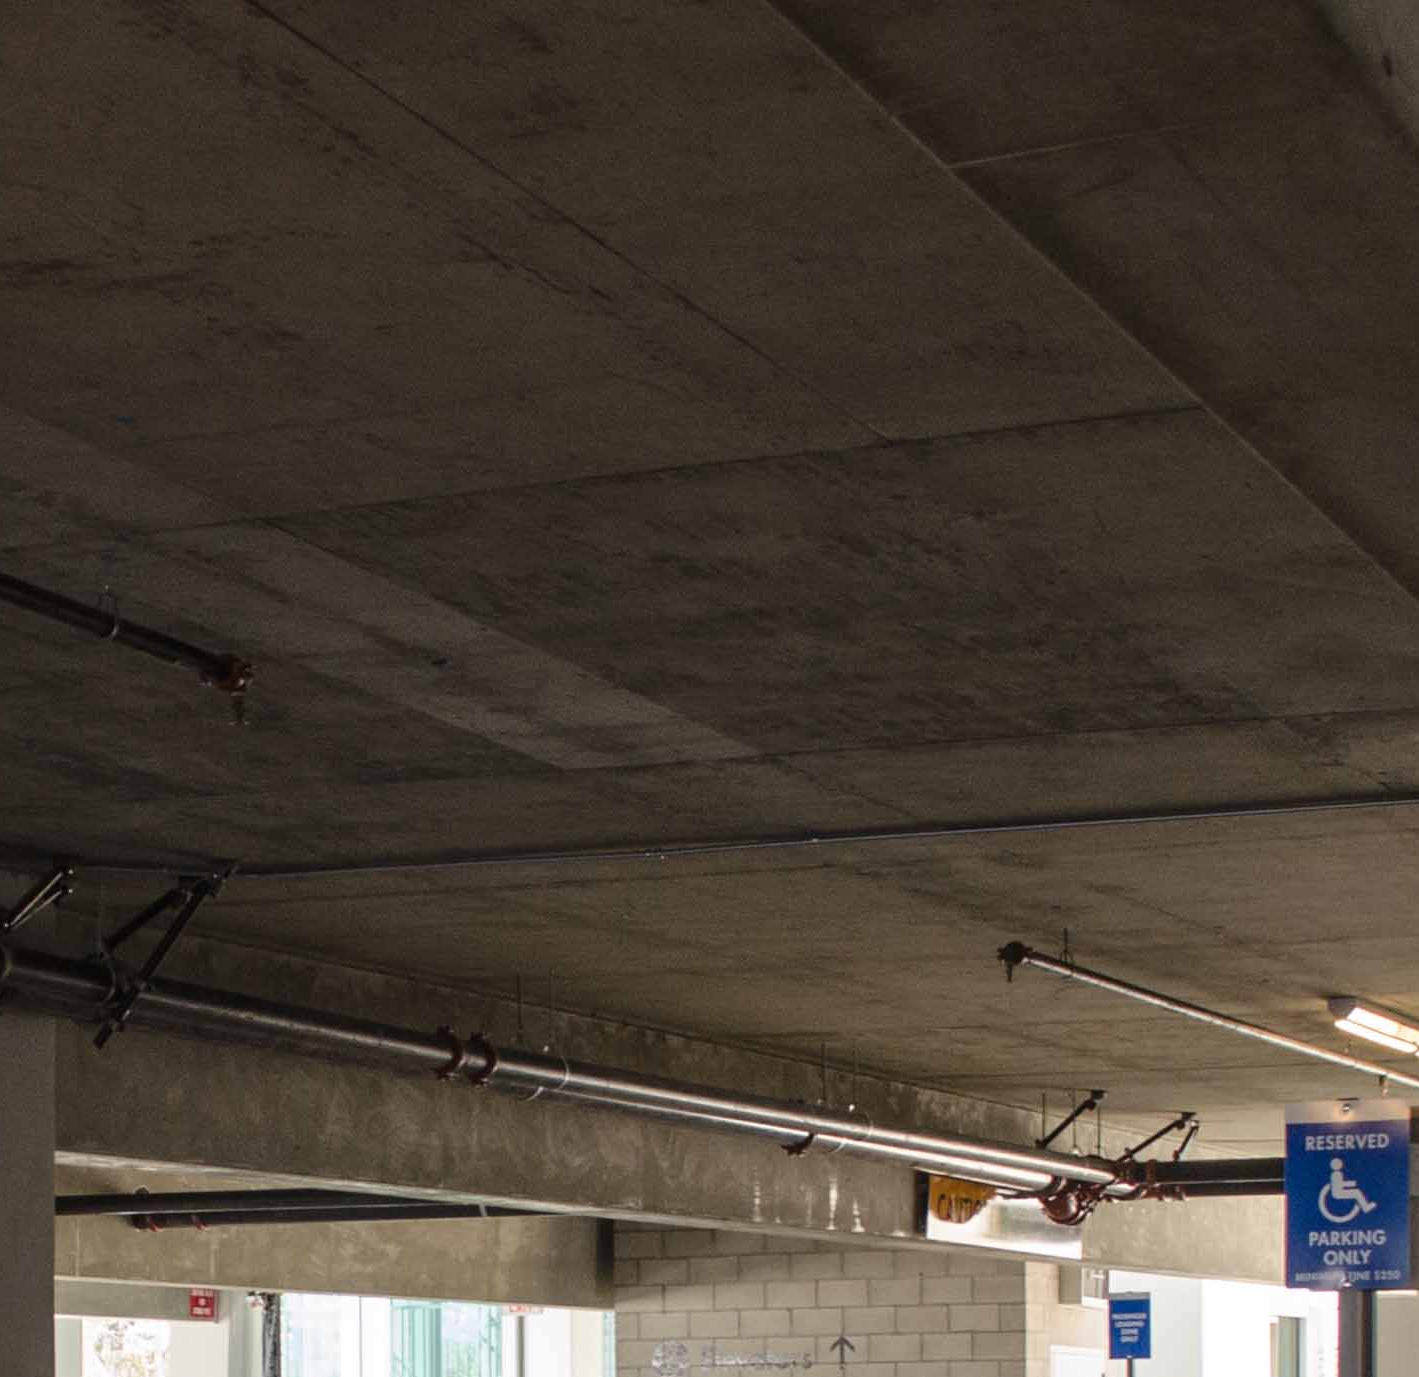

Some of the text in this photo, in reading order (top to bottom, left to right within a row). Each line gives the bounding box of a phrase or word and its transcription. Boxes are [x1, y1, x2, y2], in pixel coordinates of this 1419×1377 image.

[1305, 1134, 1389, 1151] RESERVED
[1309, 1230, 1387, 1247] PARKING
[1323, 1250, 1372, 1266] ONLY
